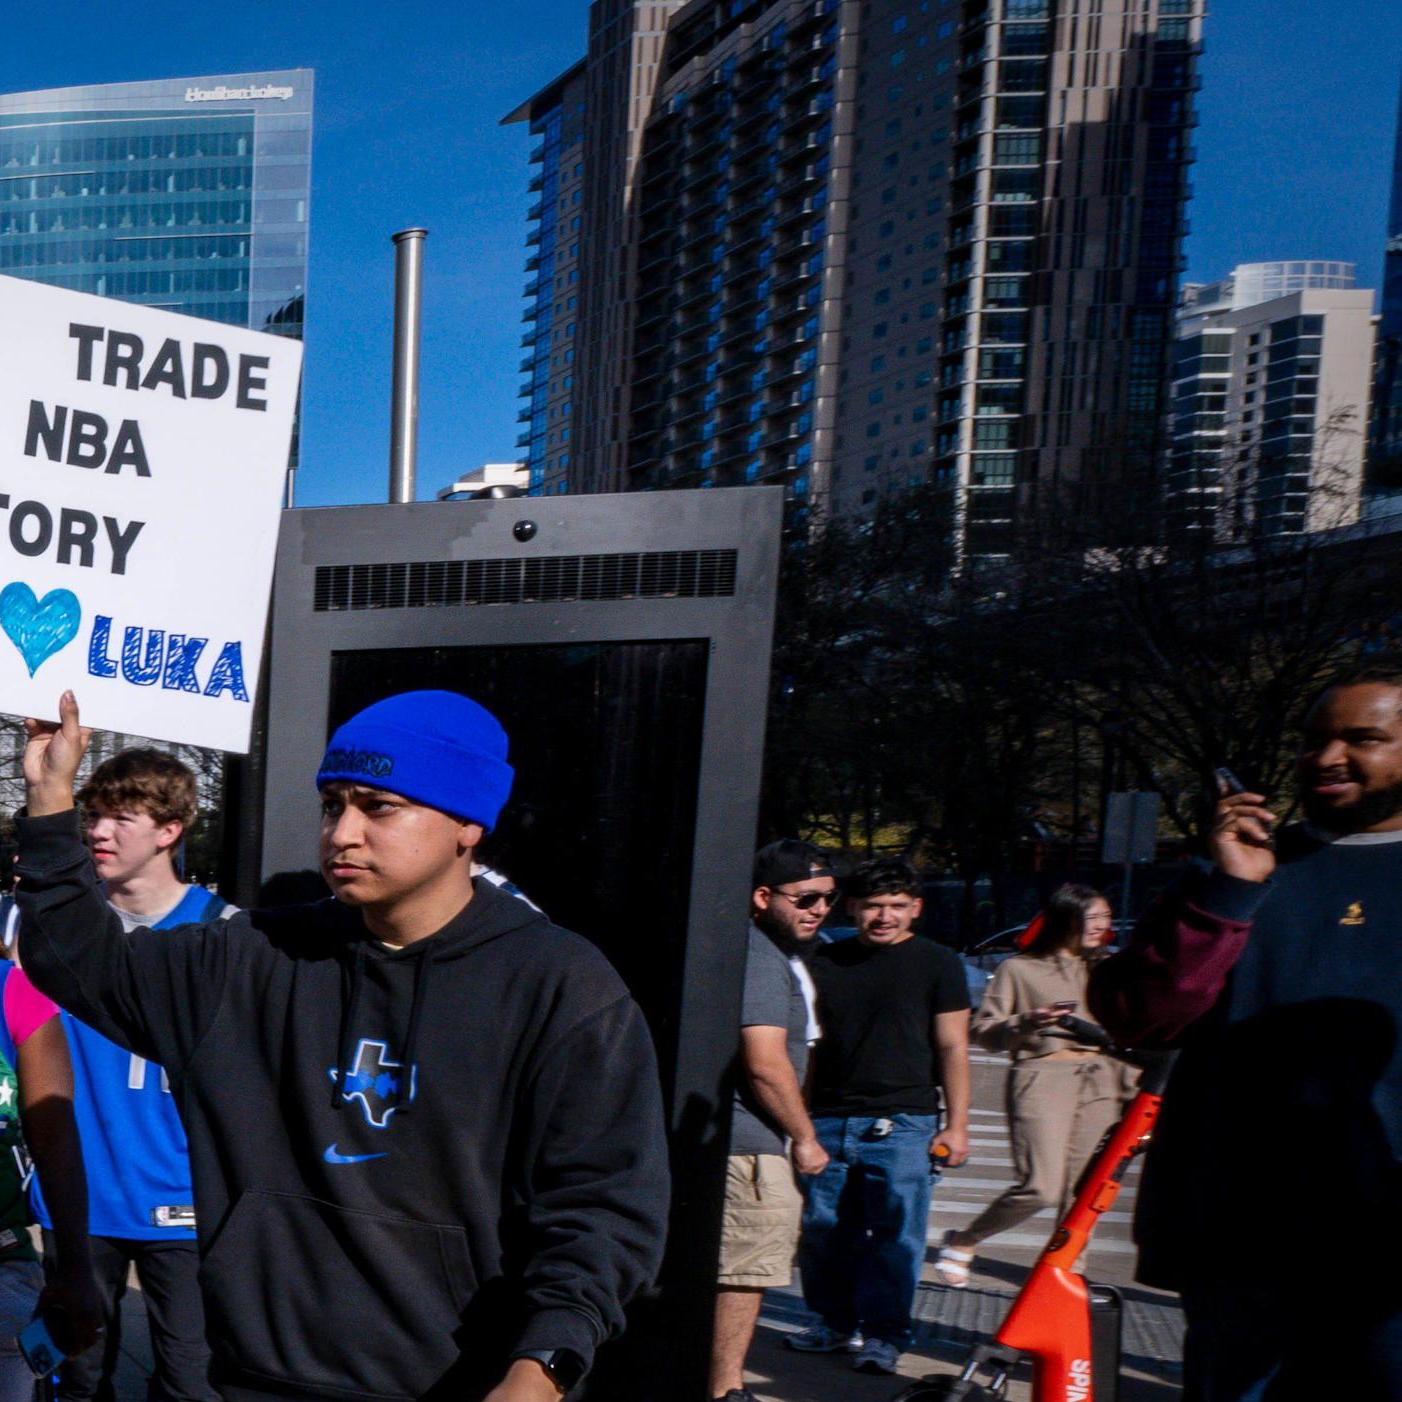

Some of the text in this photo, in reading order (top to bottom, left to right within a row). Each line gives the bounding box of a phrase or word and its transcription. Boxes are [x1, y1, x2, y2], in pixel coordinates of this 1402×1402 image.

[68, 321, 271, 412] TRADE
[23, 398, 152, 478] NBA
[87, 614, 250, 703] LUKA
